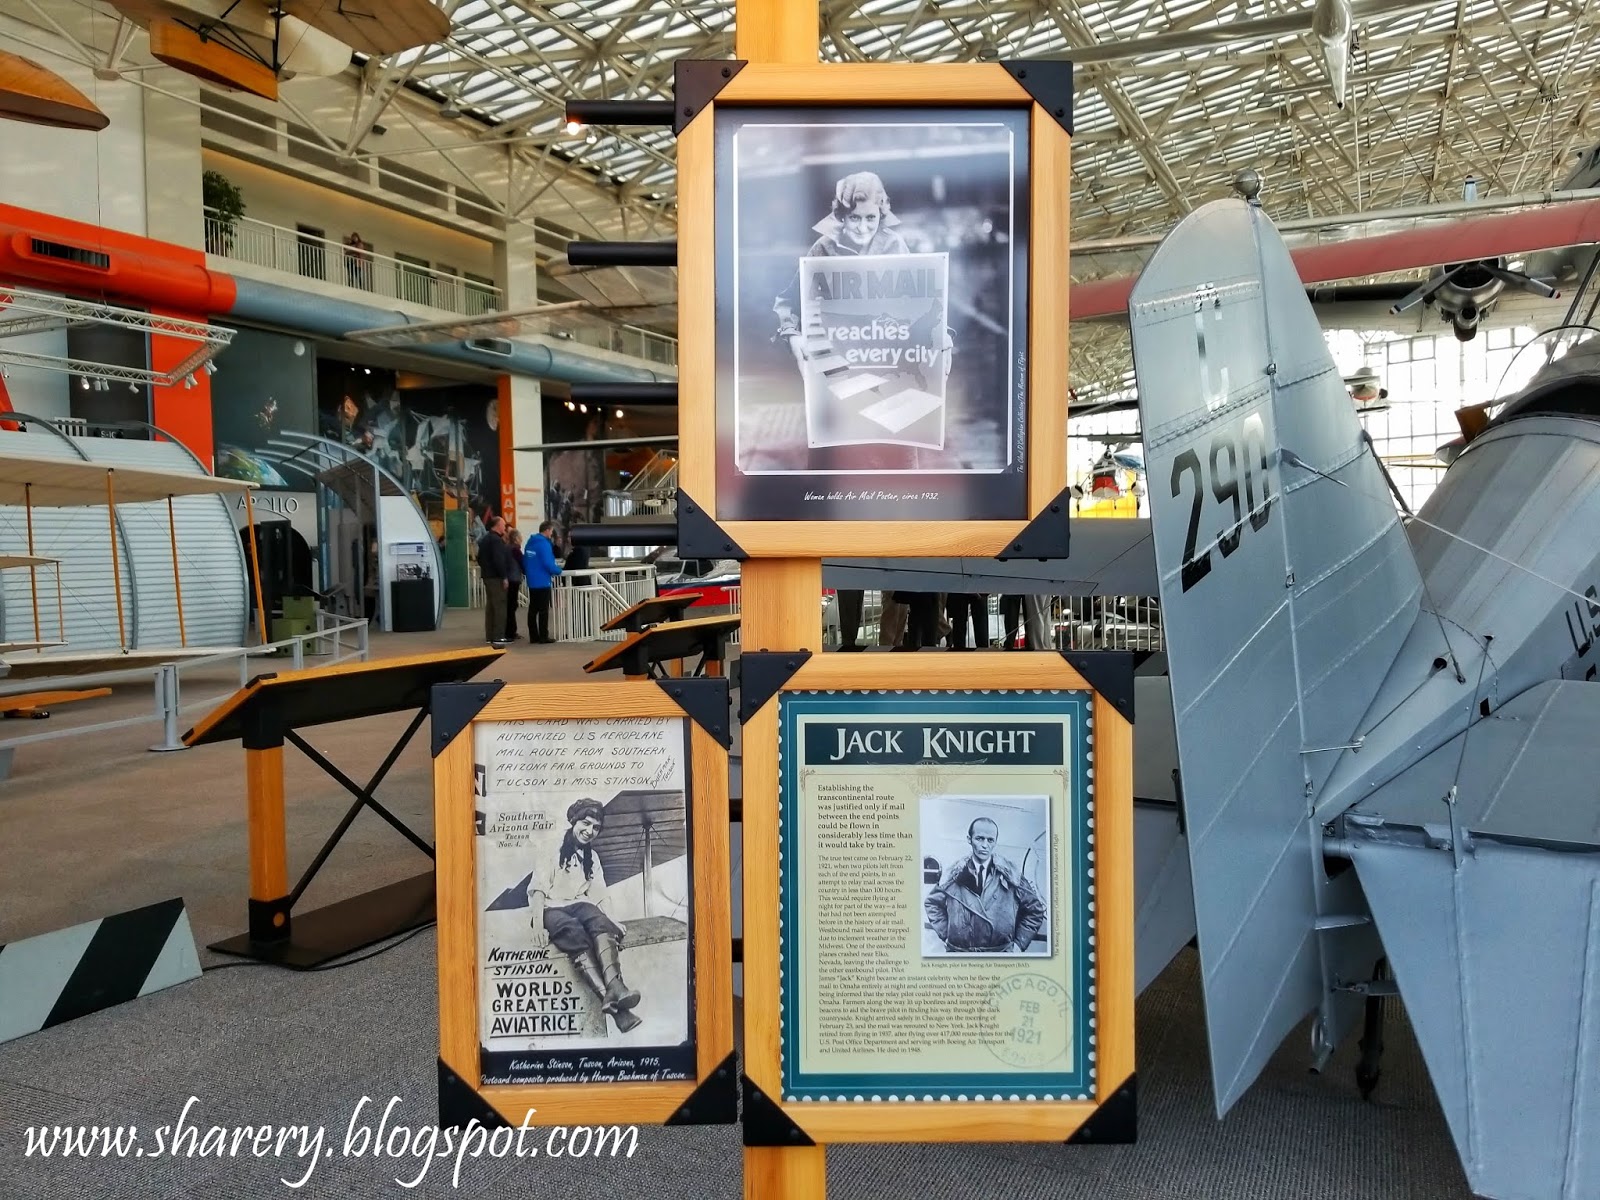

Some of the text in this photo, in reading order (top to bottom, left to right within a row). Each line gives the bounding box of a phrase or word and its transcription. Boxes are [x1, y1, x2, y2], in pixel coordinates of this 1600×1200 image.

[810, 269, 944, 300] AIR MAIL
[827, 320, 910, 340] reaches
[846, 345, 938, 367] every city
[827, 491, 843, 500] holds
[845, 491, 856, 500] Air
[859, 491, 876, 500] Mail
[876, 491, 899, 501] Poster,
[1171, 412, 1272, 593] 290
[656, 717, 670, 725] BY
[497, 732, 566, 741] AUTHORIZED
[600, 731, 664, 740] AEROPLANE
[830, 728, 1036, 760] JACK KNIGHT
[496, 748, 524, 756] MAIL
[529, 748, 568, 756] ROUTE
[612, 747, 666, 755] SOUTHERN
[496, 762, 644, 771] ARIZONA FAIR GROUNDS TO
[496, 778, 548, 786] TUCSON
[554, 778, 567, 786] BY
[571, 777, 598, 786] MISS
[818, 784, 862, 793] Establishing
[833, 803, 863, 812] justified
[864, 803, 881, 812] only
[498, 812, 544, 822] Southern
[876, 812, 900, 821] points
[489, 822, 528, 833] Arizona
[532, 821, 554, 830] Fair
[818, 831, 864, 840] considerably
[865, 841, 875, 850] by
[488, 947, 550, 962] KATHERINE
[497, 981, 573, 998] WORLDS
[1020, 1000, 1040, 1013] FEB
[1012, 1027, 1041, 1045] 1921
[509, 1060, 544, 1070] Katherine
[640, 1057, 660, 1067] 1915.
[512, 1074, 544, 1085] composite
[546, 1074, 578, 1084] produced
[580, 1073, 588, 1084] by
[591, 1072, 614, 1083] Henry
